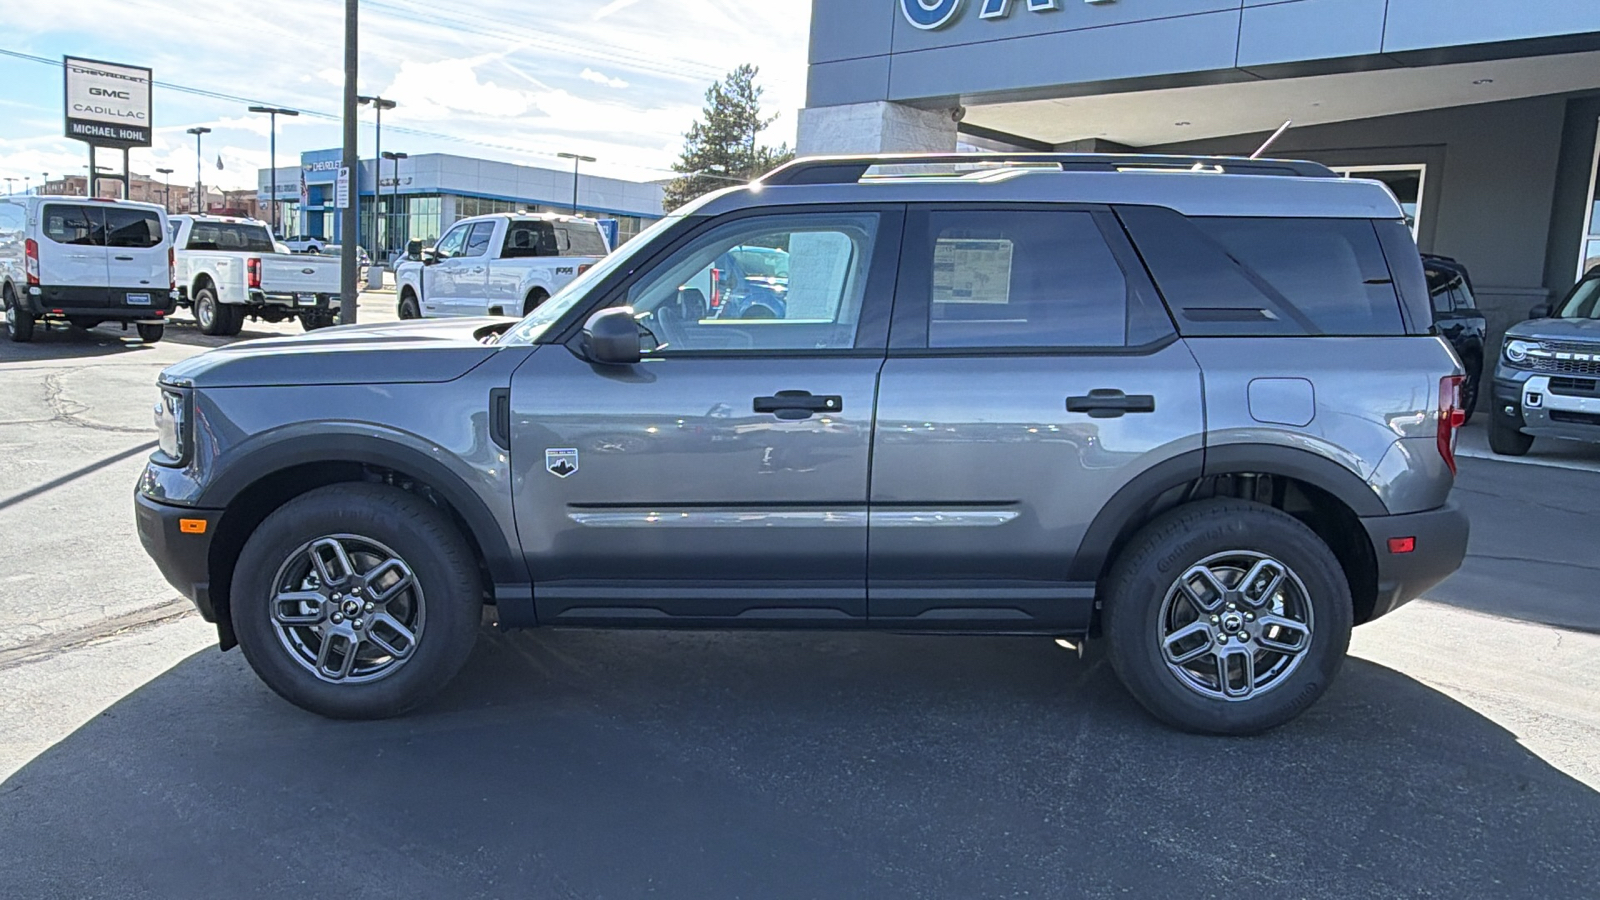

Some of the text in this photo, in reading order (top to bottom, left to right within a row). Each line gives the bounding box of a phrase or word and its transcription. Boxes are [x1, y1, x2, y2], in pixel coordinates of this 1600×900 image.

[72, 67, 145, 83] CHEVROLET
[89, 87, 130, 100] GMC
[73, 103, 145, 120] CADILLAC
[73, 123, 145, 141] MICHAEL HOHL
